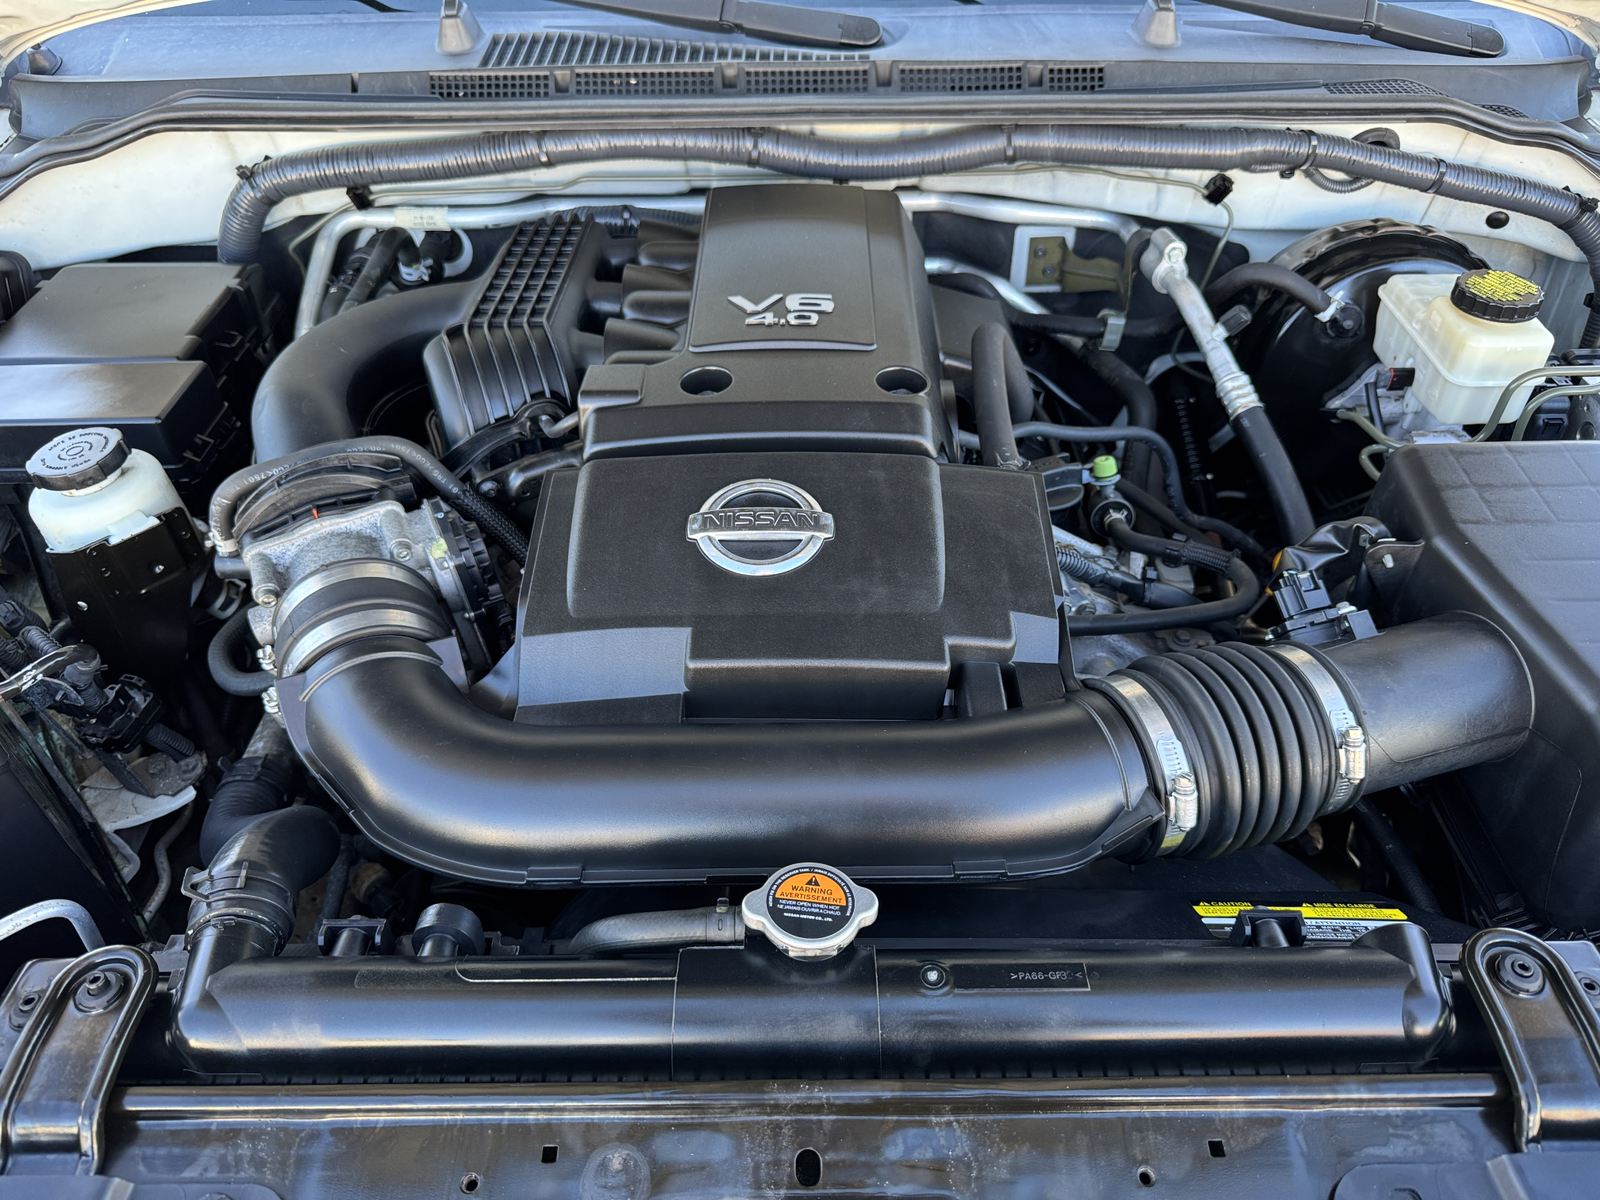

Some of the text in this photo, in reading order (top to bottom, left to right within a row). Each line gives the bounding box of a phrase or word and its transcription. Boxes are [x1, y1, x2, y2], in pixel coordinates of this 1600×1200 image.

[727, 293, 835, 314] V6
[745, 312, 819, 326] 4.0
[703, 512, 820, 530] NISSAN
[792, 885, 832, 895] WARNING
[780, 892, 842, 904] AVERTISSEMENT
